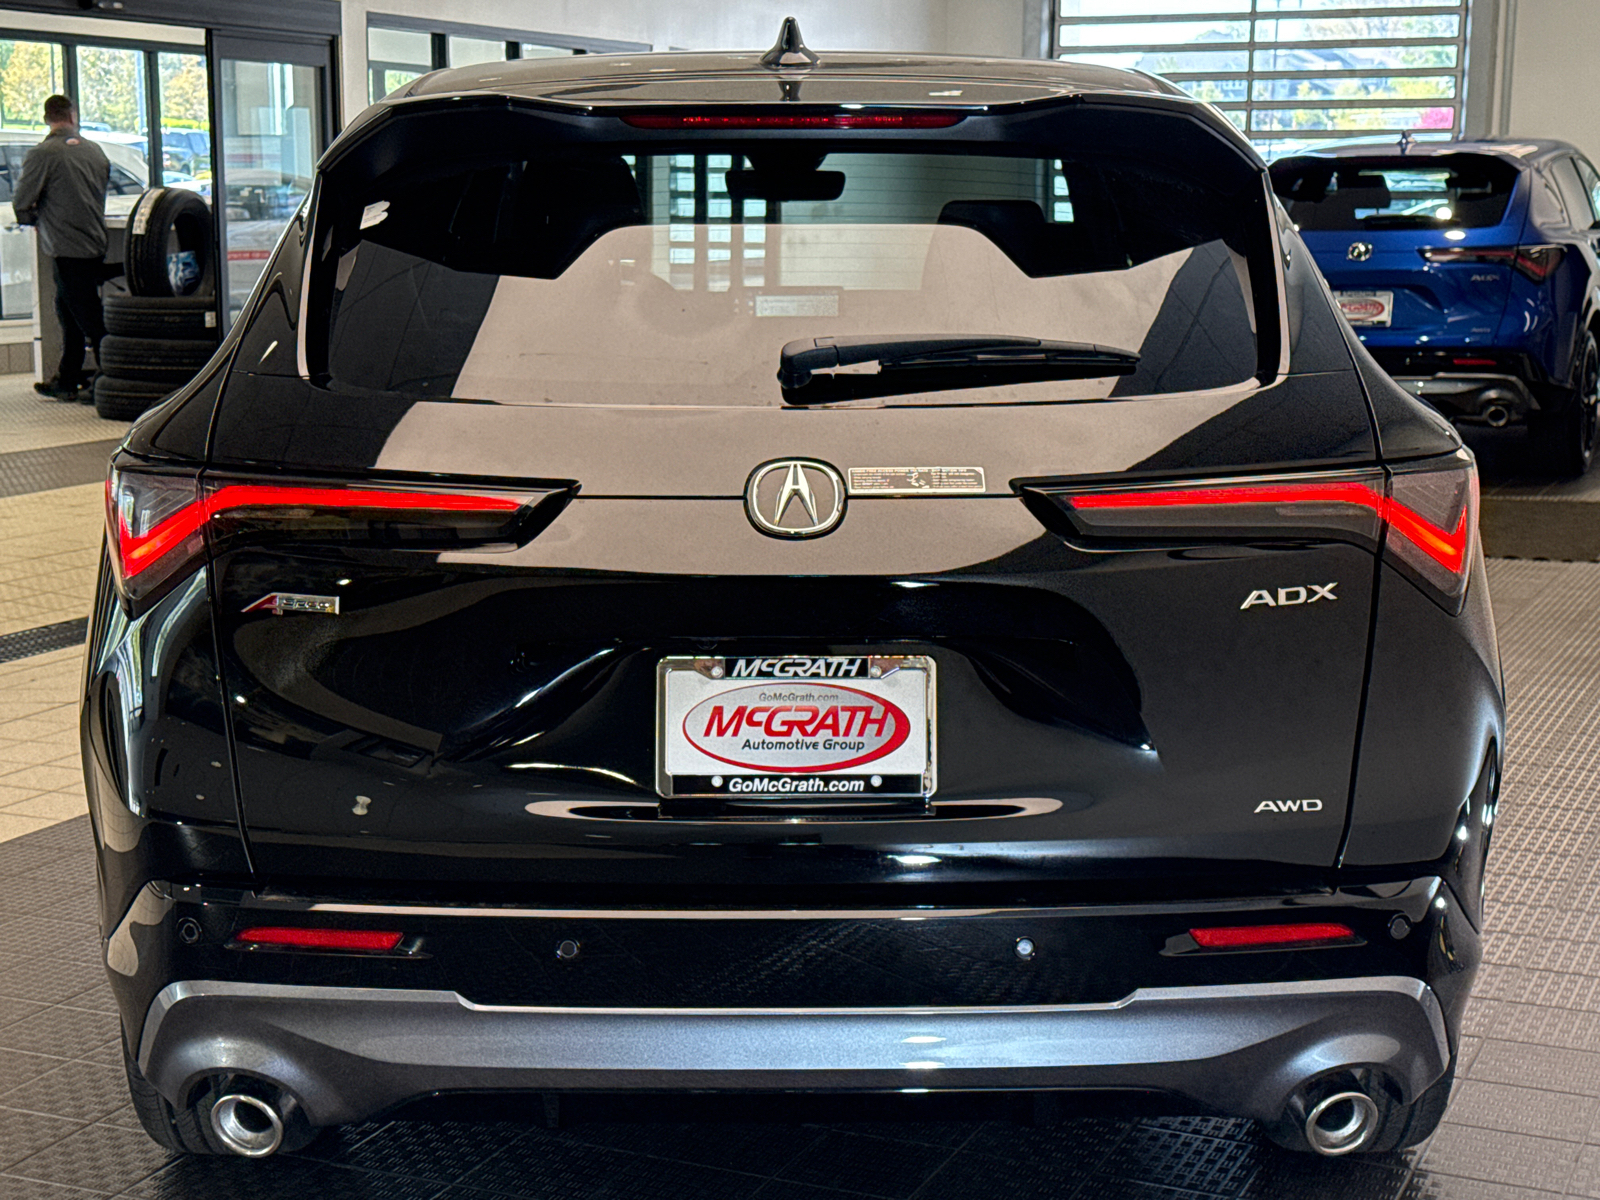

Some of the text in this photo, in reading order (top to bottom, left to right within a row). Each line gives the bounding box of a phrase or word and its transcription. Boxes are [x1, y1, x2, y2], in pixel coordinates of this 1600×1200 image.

[1240, 582, 1338, 610] ADX
[731, 658, 862, 677] McGRATH
[758, 692, 839, 702] GoMcGrath.com
[703, 705, 889, 737] McGRATH
[742, 738, 865, 752] Automotive Group
[728, 777, 865, 793] GoMcGrath.com
[1253, 799, 1323, 813] AWD
